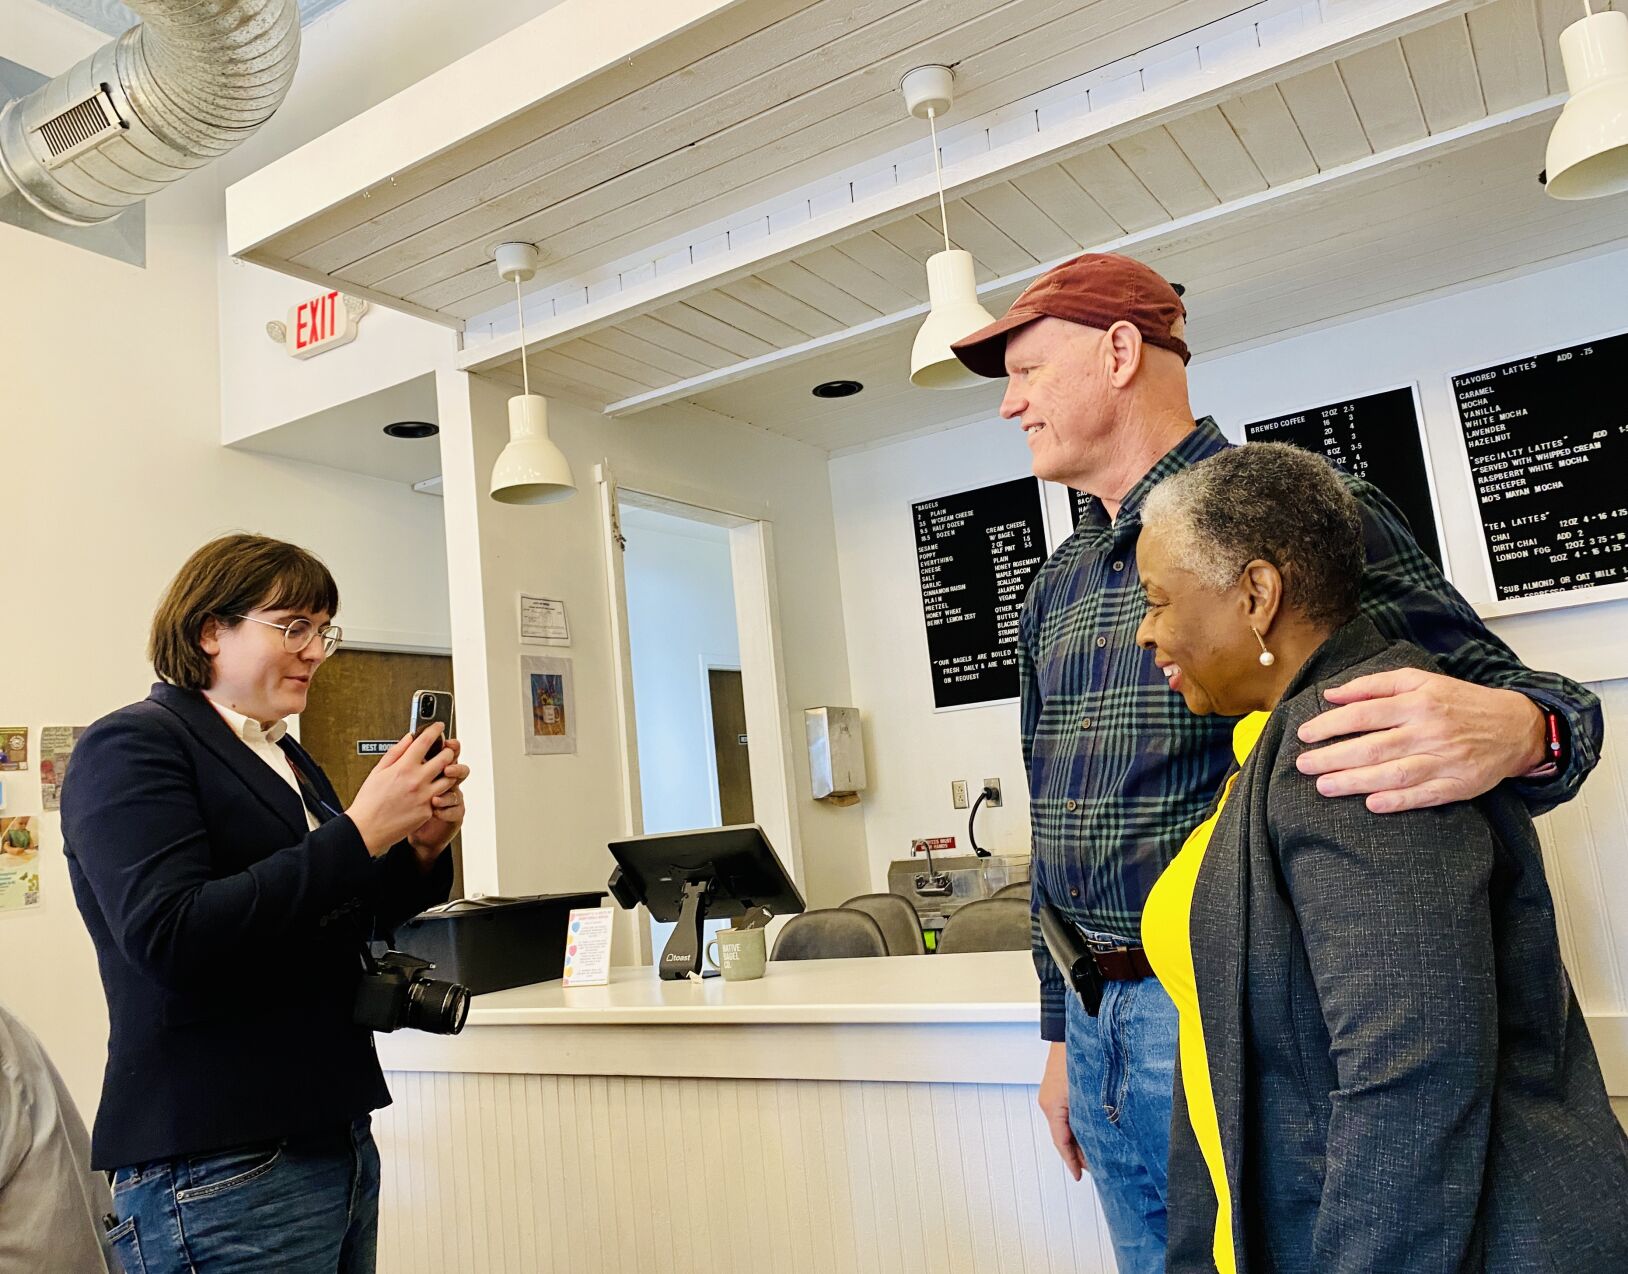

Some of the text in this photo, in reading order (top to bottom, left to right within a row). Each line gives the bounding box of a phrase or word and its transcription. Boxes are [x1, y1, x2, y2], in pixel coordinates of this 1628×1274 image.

[296, 290, 338, 349] EXIT
[1556, 352, 1573, 362] ADD
[1459, 386, 1495, 400] CARAMEL
[1461, 397, 1489, 410] MOCHA
[1348, 413, 1354, 421] 3
[1463, 404, 1502, 419] VANILLA
[1250, 422, 1279, 434] BREWED
[1280, 415, 1306, 427] COFFEE
[1343, 404, 1355, 413] 2.5
[1464, 408, 1529, 429] WHITE MOCHA
[1324, 422, 1355, 436] 20 4
[1466, 423, 1506, 439] LAVENDER
[1592, 429, 1608, 440] ADD
[1323, 437, 1338, 446] DBL
[1467, 432, 1511, 448] HAZELNUT
[1355, 453, 1361, 461] 4
[1511, 456, 1533, 467] WITH
[1535, 447, 1572, 462] WHIPPED
[1572, 441, 1602, 454] CREAM
[1477, 454, 1590, 485] RASPBERRY WHITE MOCHA
[1479, 478, 1527, 494] BEEKEEPER
[1505, 487, 1531, 499] MAYAN
[1533, 480, 1564, 494] MOCHA
[930, 509, 947, 518] PLAIN
[955, 510, 974, 519] CHEESE
[932, 523, 946, 532] HALF
[946, 520, 965, 529] DOZEN
[985, 520, 1026, 534] CREAM CHEESE
[1490, 532, 1511, 542] CHAI
[1583, 515, 1590, 523] 4
[936, 529, 956, 539] DOZEN
[997, 530, 1015, 540] BAGEL
[1492, 529, 1585, 553] DIRTY CHAI ADD 2
[918, 543, 939, 553] SESAME
[991, 547, 1004, 555] HALF
[1004, 544, 1016, 552] PINT
[919, 551, 936, 560] POPPY
[993, 555, 1009, 564] PLAIN
[1495, 549, 1529, 562] LONDON
[1533, 546, 1551, 556] FOG
[1574, 550, 1581, 558] 4
[920, 555, 954, 568] EVERYTHING
[994, 556, 1041, 571] HONEY ROSEMARY
[920, 565, 942, 575] CHEESE
[995, 566, 1031, 579] MAPLE BACON
[921, 574, 935, 583] SALT
[996, 576, 1021, 587] SCALLION
[1522, 578, 1555, 591] ALMOND
[1560, 575, 1572, 585] OR
[1576, 572, 1591, 582] OAT
[1594, 567, 1617, 579] MILK
[922, 580, 942, 590] GARLIC
[923, 583, 967, 597] CINNAMON RAISIN
[997, 583, 1025, 594] JALAPENO
[924, 595, 943, 604] PLAIN
[998, 593, 1017, 602] VEGAN
[925, 602, 950, 612] PRETZEL
[994, 604, 1013, 614] OTHER
[926, 607, 962, 619] HONEY WHEAT
[996, 611, 1018, 621] BUTTER
[926, 612, 977, 627] BERRY LEMON ZEST
[997, 619, 1020, 629] BLACKBE
[997, 627, 1018, 637] STRAWB
[952, 655, 972, 664] BAGELS
[977, 652, 987, 660] ARE
[991, 649, 1012, 658] BOILED
[943, 666, 960, 675] FRESH
[963, 663, 979, 672] DAILY
[987, 660, 998, 668] ARE
[1002, 658, 1017, 666] ONLY
[955, 672, 980, 683] REQUEST
[361, 743, 393, 752] REST ROO
[673, 953, 691, 962] toast
[723, 952, 740, 961] BAGEL
